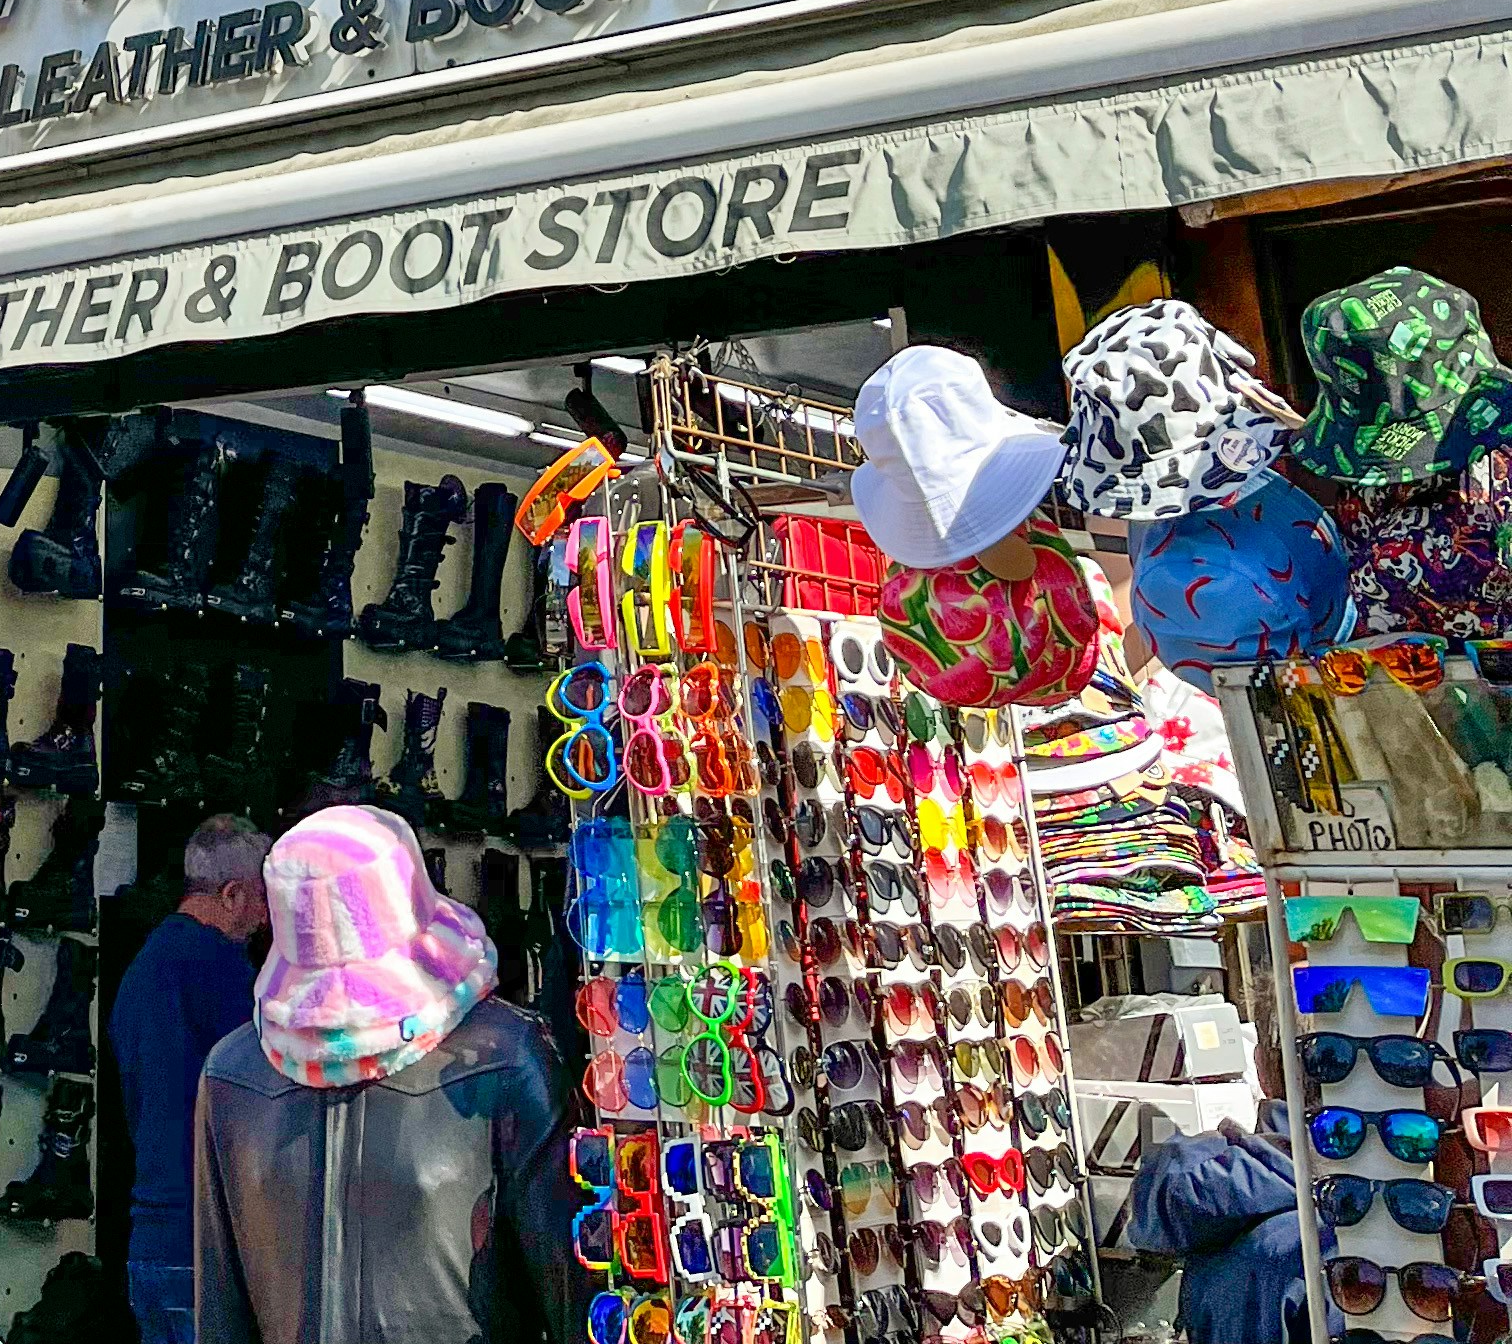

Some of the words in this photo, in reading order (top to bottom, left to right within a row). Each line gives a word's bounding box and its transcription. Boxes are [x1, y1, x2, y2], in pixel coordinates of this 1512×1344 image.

[184, 253, 238, 323] &
[265, 206, 514, 315] BOOT
[523, 147, 864, 272] STORE
[1308, 817, 1391, 852] PHOTO
